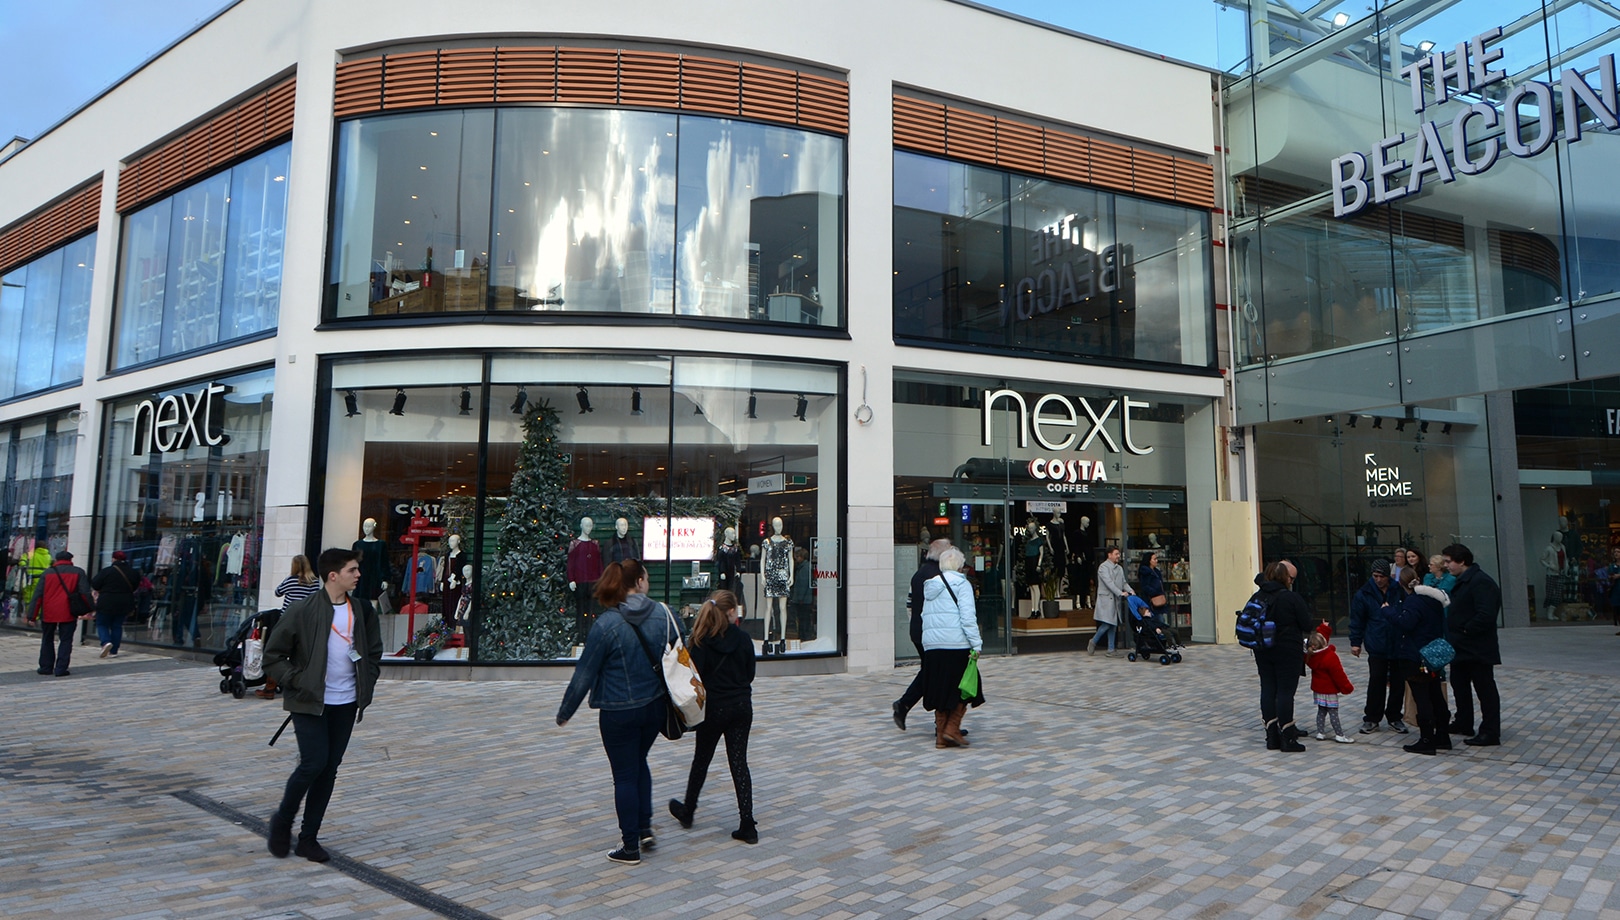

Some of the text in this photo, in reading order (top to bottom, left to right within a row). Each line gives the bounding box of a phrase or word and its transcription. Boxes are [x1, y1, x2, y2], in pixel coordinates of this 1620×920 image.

[1400, 26, 1506, 114] THE
[1331, 53, 1620, 218] BEACON
[131, 382, 225, 456] next
[982, 388, 1154, 455] next
[1029, 457, 1108, 484] COSTA
[1046, 483, 1089, 493] COFFEE
[1365, 466, 1400, 482] MEN
[1366, 481, 1413, 497] HOME
